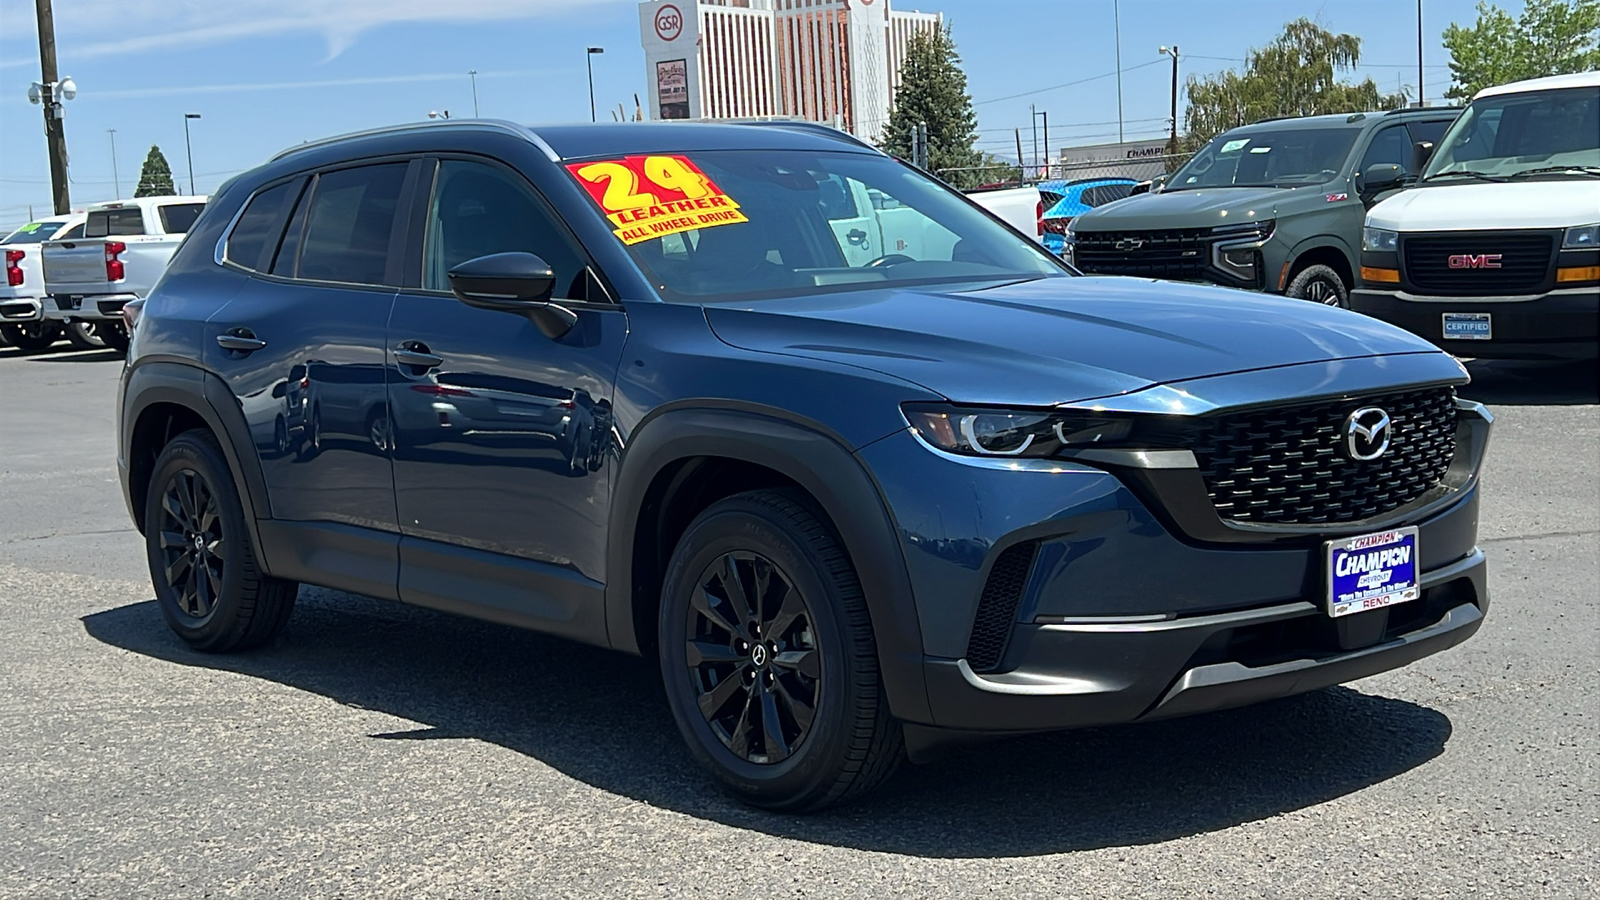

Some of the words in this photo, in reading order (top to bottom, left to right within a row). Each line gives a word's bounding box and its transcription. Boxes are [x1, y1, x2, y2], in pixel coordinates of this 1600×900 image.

[658, 14, 679, 31] GSR
[1127, 147, 1164, 158] CHAMPI
[577, 156, 716, 211] 24
[616, 197, 728, 225] LEATHER
[621, 226, 650, 242] ALL
[648, 216, 697, 234] WHEEL
[697, 210, 739, 225] DRIVE
[1448, 254, 1503, 269] GMC
[1446, 323, 1489, 331] CERTIFIED
[1354, 532, 1396, 549] CHAMPION
[1336, 545, 1411, 577] CHAMPION
[1360, 572, 1389, 584] CHEVROLET
[1362, 595, 1390, 609] RENO
